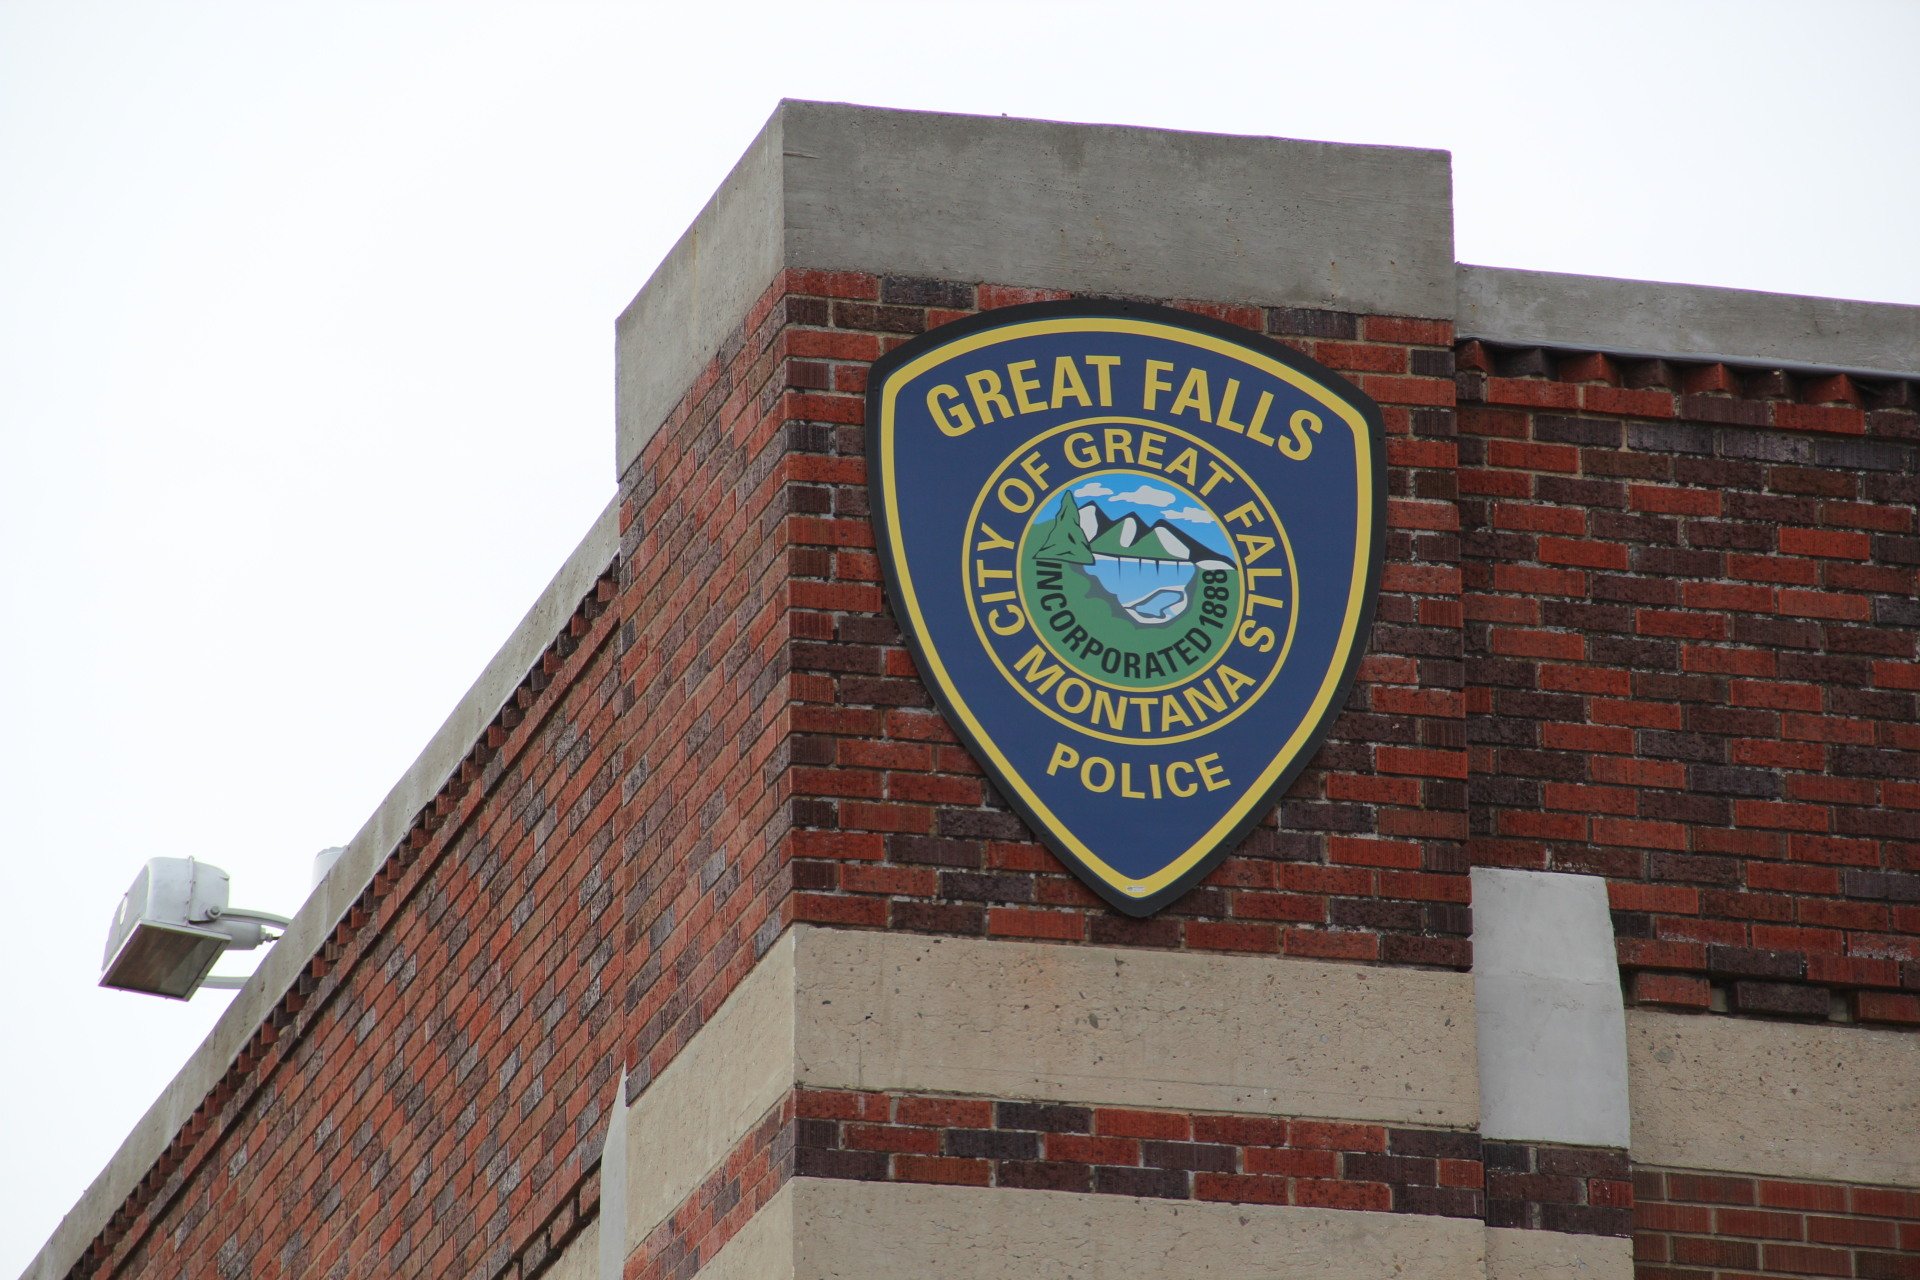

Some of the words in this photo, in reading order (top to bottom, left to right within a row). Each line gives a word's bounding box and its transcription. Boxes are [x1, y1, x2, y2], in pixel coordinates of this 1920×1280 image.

[926, 355, 1121, 437] GREAT
[1144, 359, 1323, 462] FALLS
[997, 451, 1052, 515] OF
[1064, 428, 1234, 497] GREAT
[976, 525, 1025, 637] CITY
[1036, 561, 1213, 680] INCORPORATED
[1198, 568, 1230, 630] 1888
[1224, 500, 1284, 654] FALLS
[1015, 646, 1256, 733] MONTANA
[1046, 742, 1231, 800] POLICE
